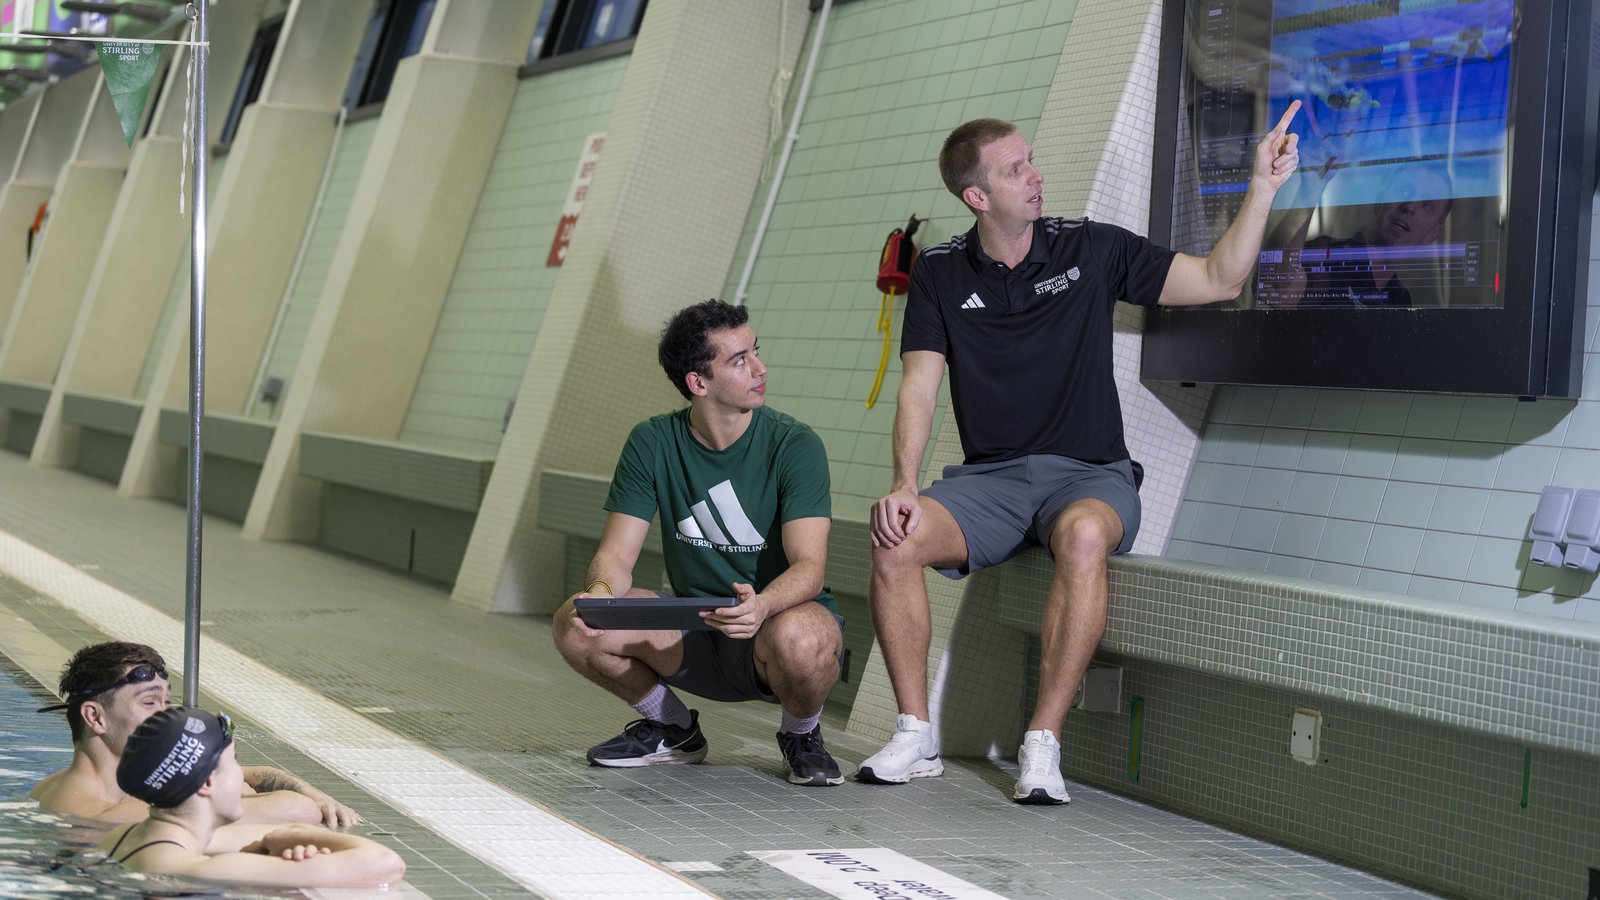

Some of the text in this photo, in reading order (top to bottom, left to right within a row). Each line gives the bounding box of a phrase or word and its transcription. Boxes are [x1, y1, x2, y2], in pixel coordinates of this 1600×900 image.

[1034, 275, 1061, 288] UNIVERSITY
[1035, 278, 1068, 295] STIRLING
[1052, 283, 1069, 295] SPORT
[728, 543, 768, 553] STIRLING
[144, 733, 189, 785] UNIVERSITY of
[152, 737, 198, 790] STIRLING
[180, 741, 206, 775] SPORT
